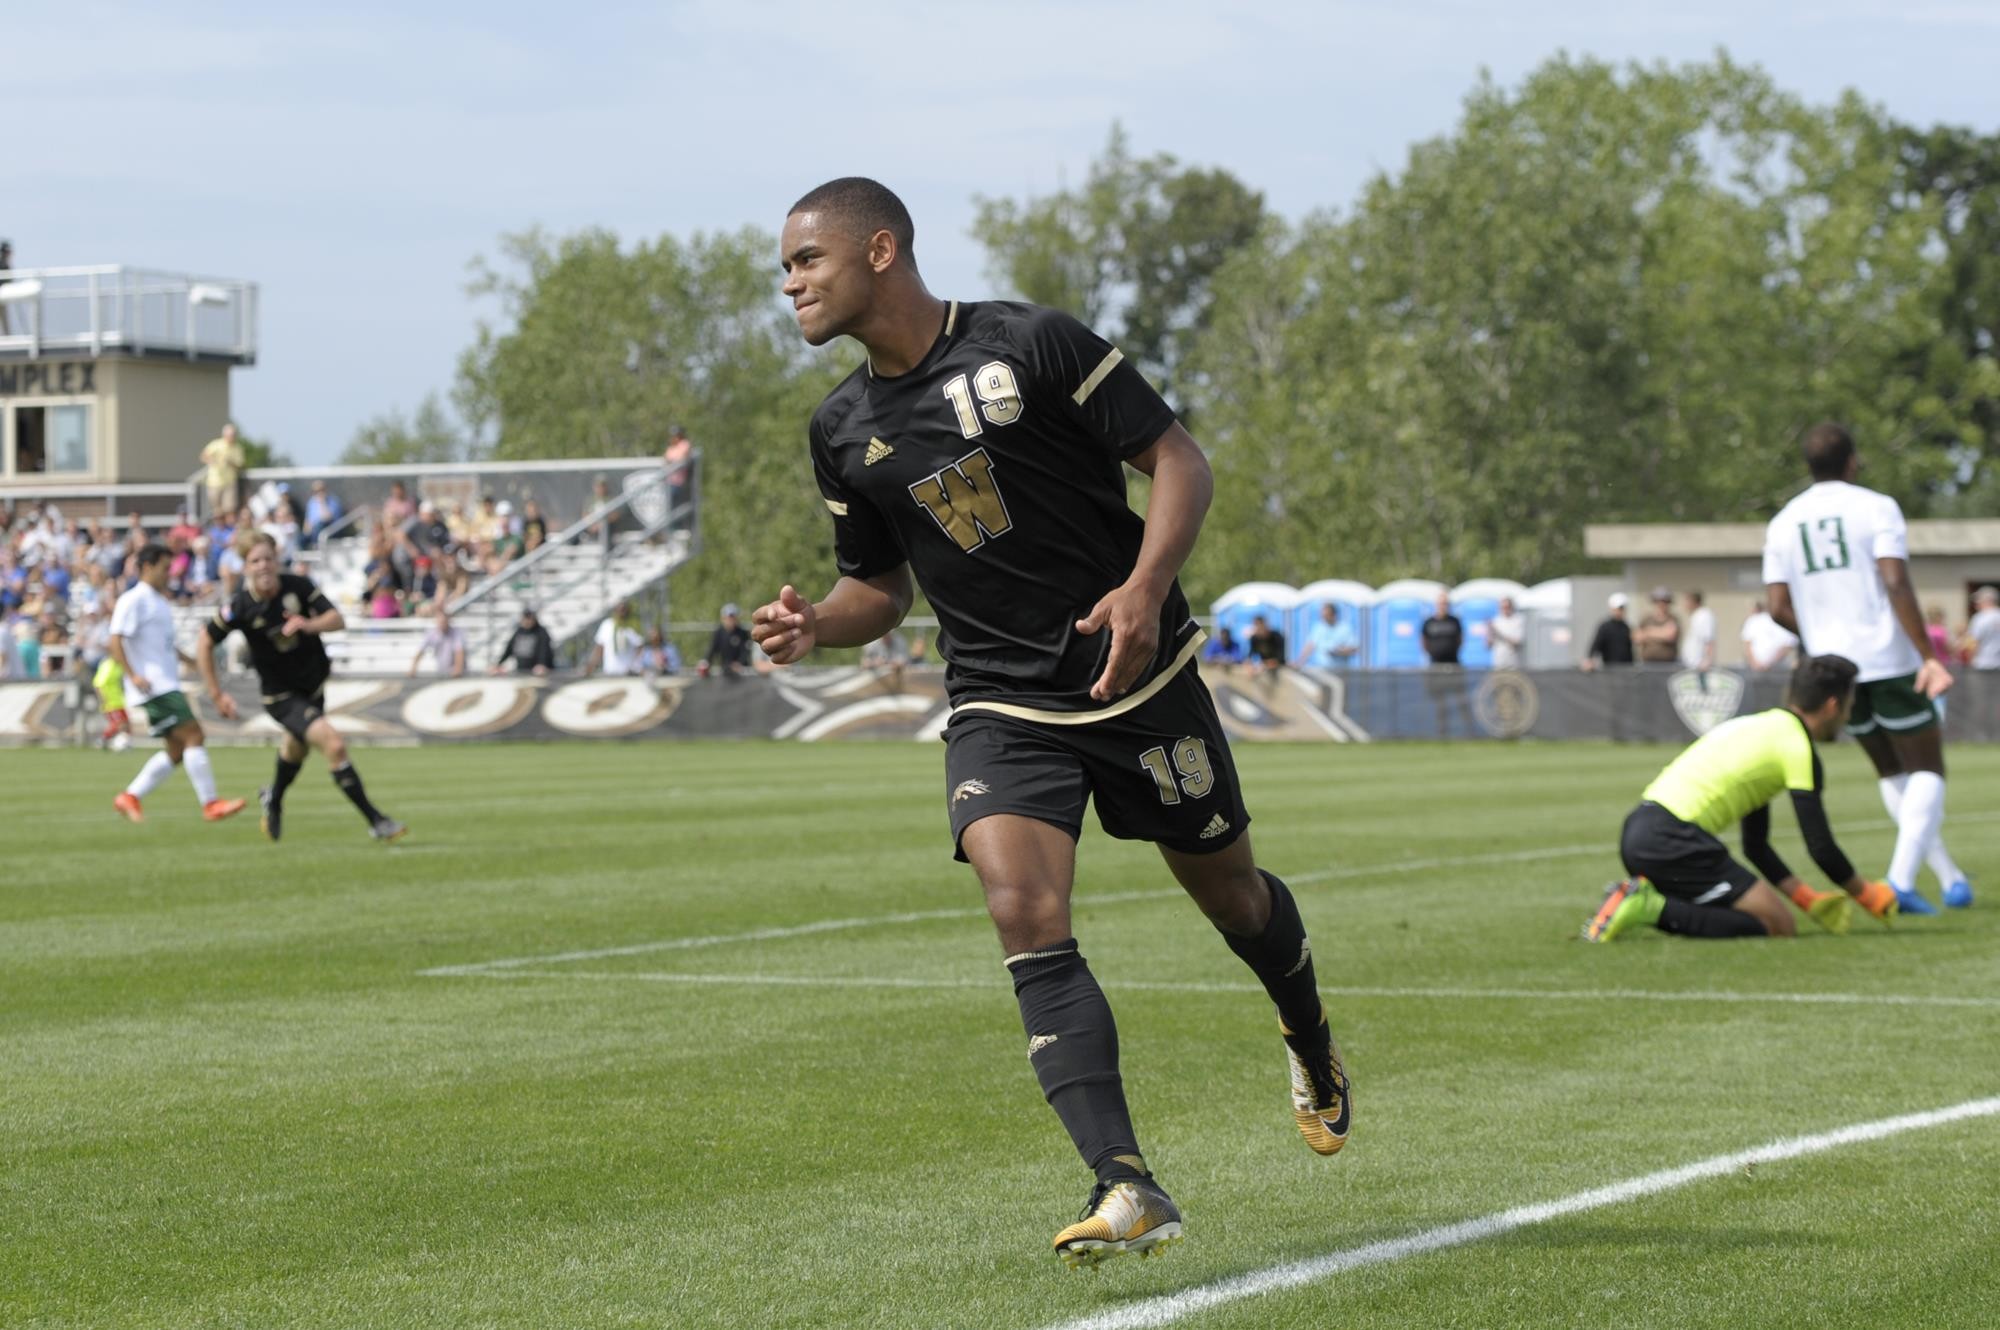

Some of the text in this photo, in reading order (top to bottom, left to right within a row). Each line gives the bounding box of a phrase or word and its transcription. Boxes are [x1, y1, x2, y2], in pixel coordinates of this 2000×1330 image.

[943, 361, 1024, 440] 19
[864, 445, 894, 467] adidas
[908, 446, 1013, 554] W
[1797, 516, 1851, 576] 13
[1139, 736, 1214, 805] 19
[1199, 821, 1231, 839] adidas
